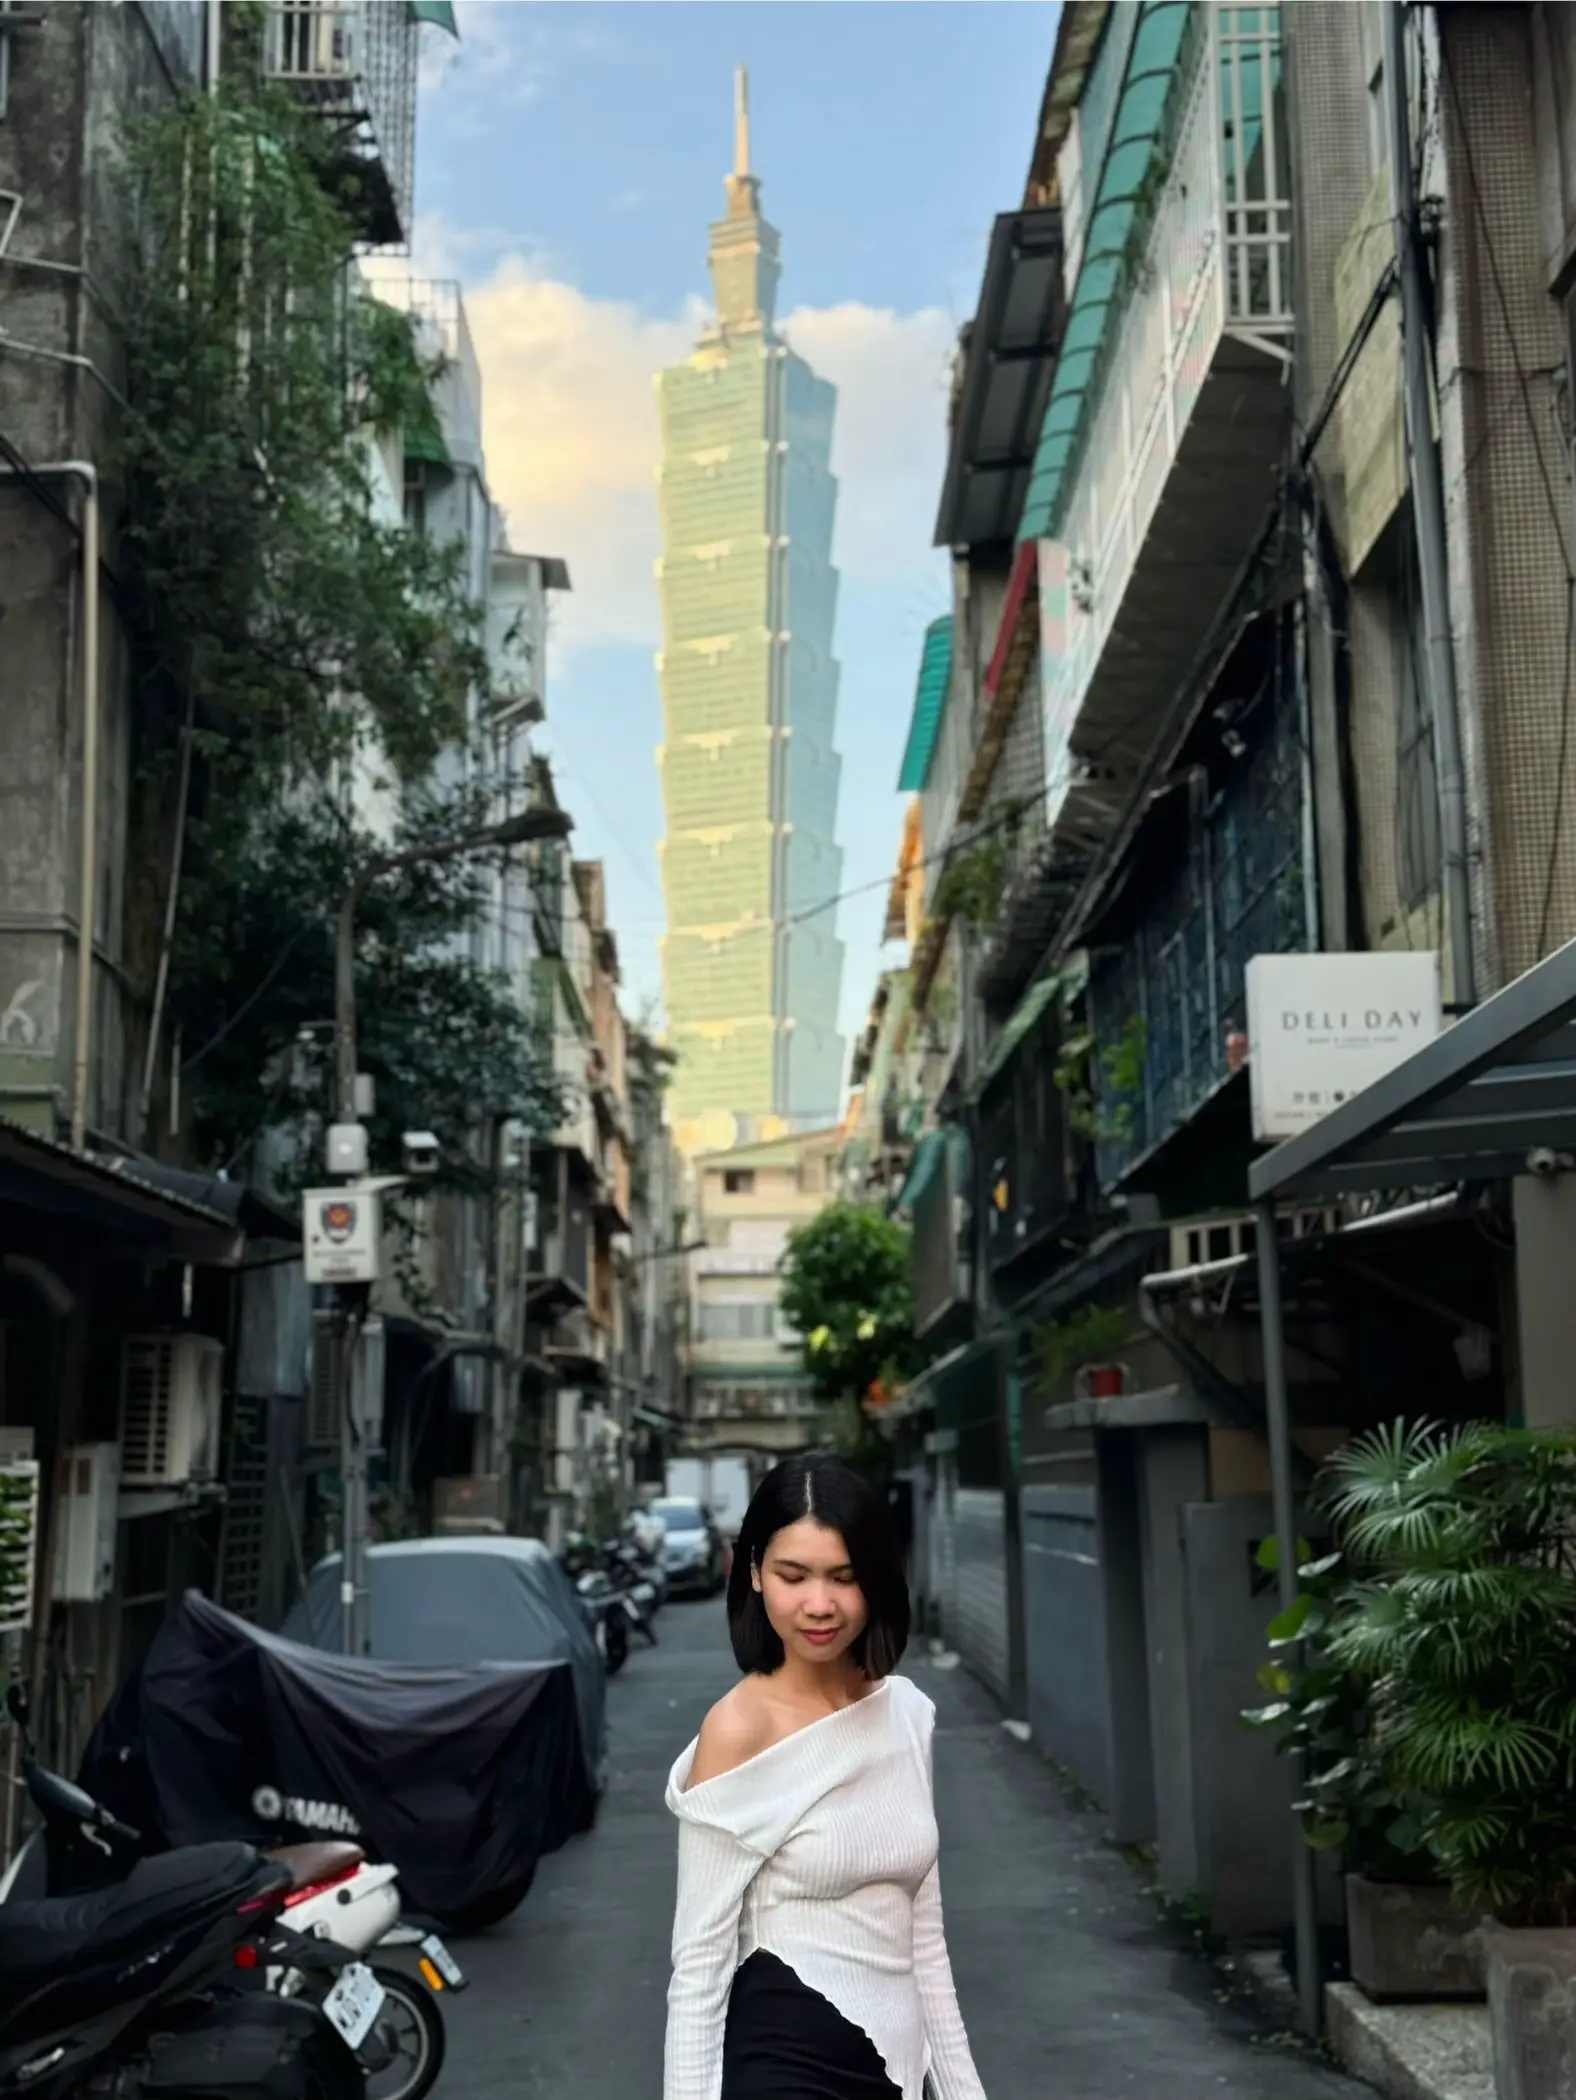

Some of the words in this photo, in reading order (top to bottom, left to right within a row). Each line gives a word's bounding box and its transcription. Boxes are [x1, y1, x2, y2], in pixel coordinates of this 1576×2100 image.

[1282, 1010, 1347, 1031] DELI
[1363, 1008, 1422, 1030] DAY
[284, 1795, 361, 1837] YAMAH
